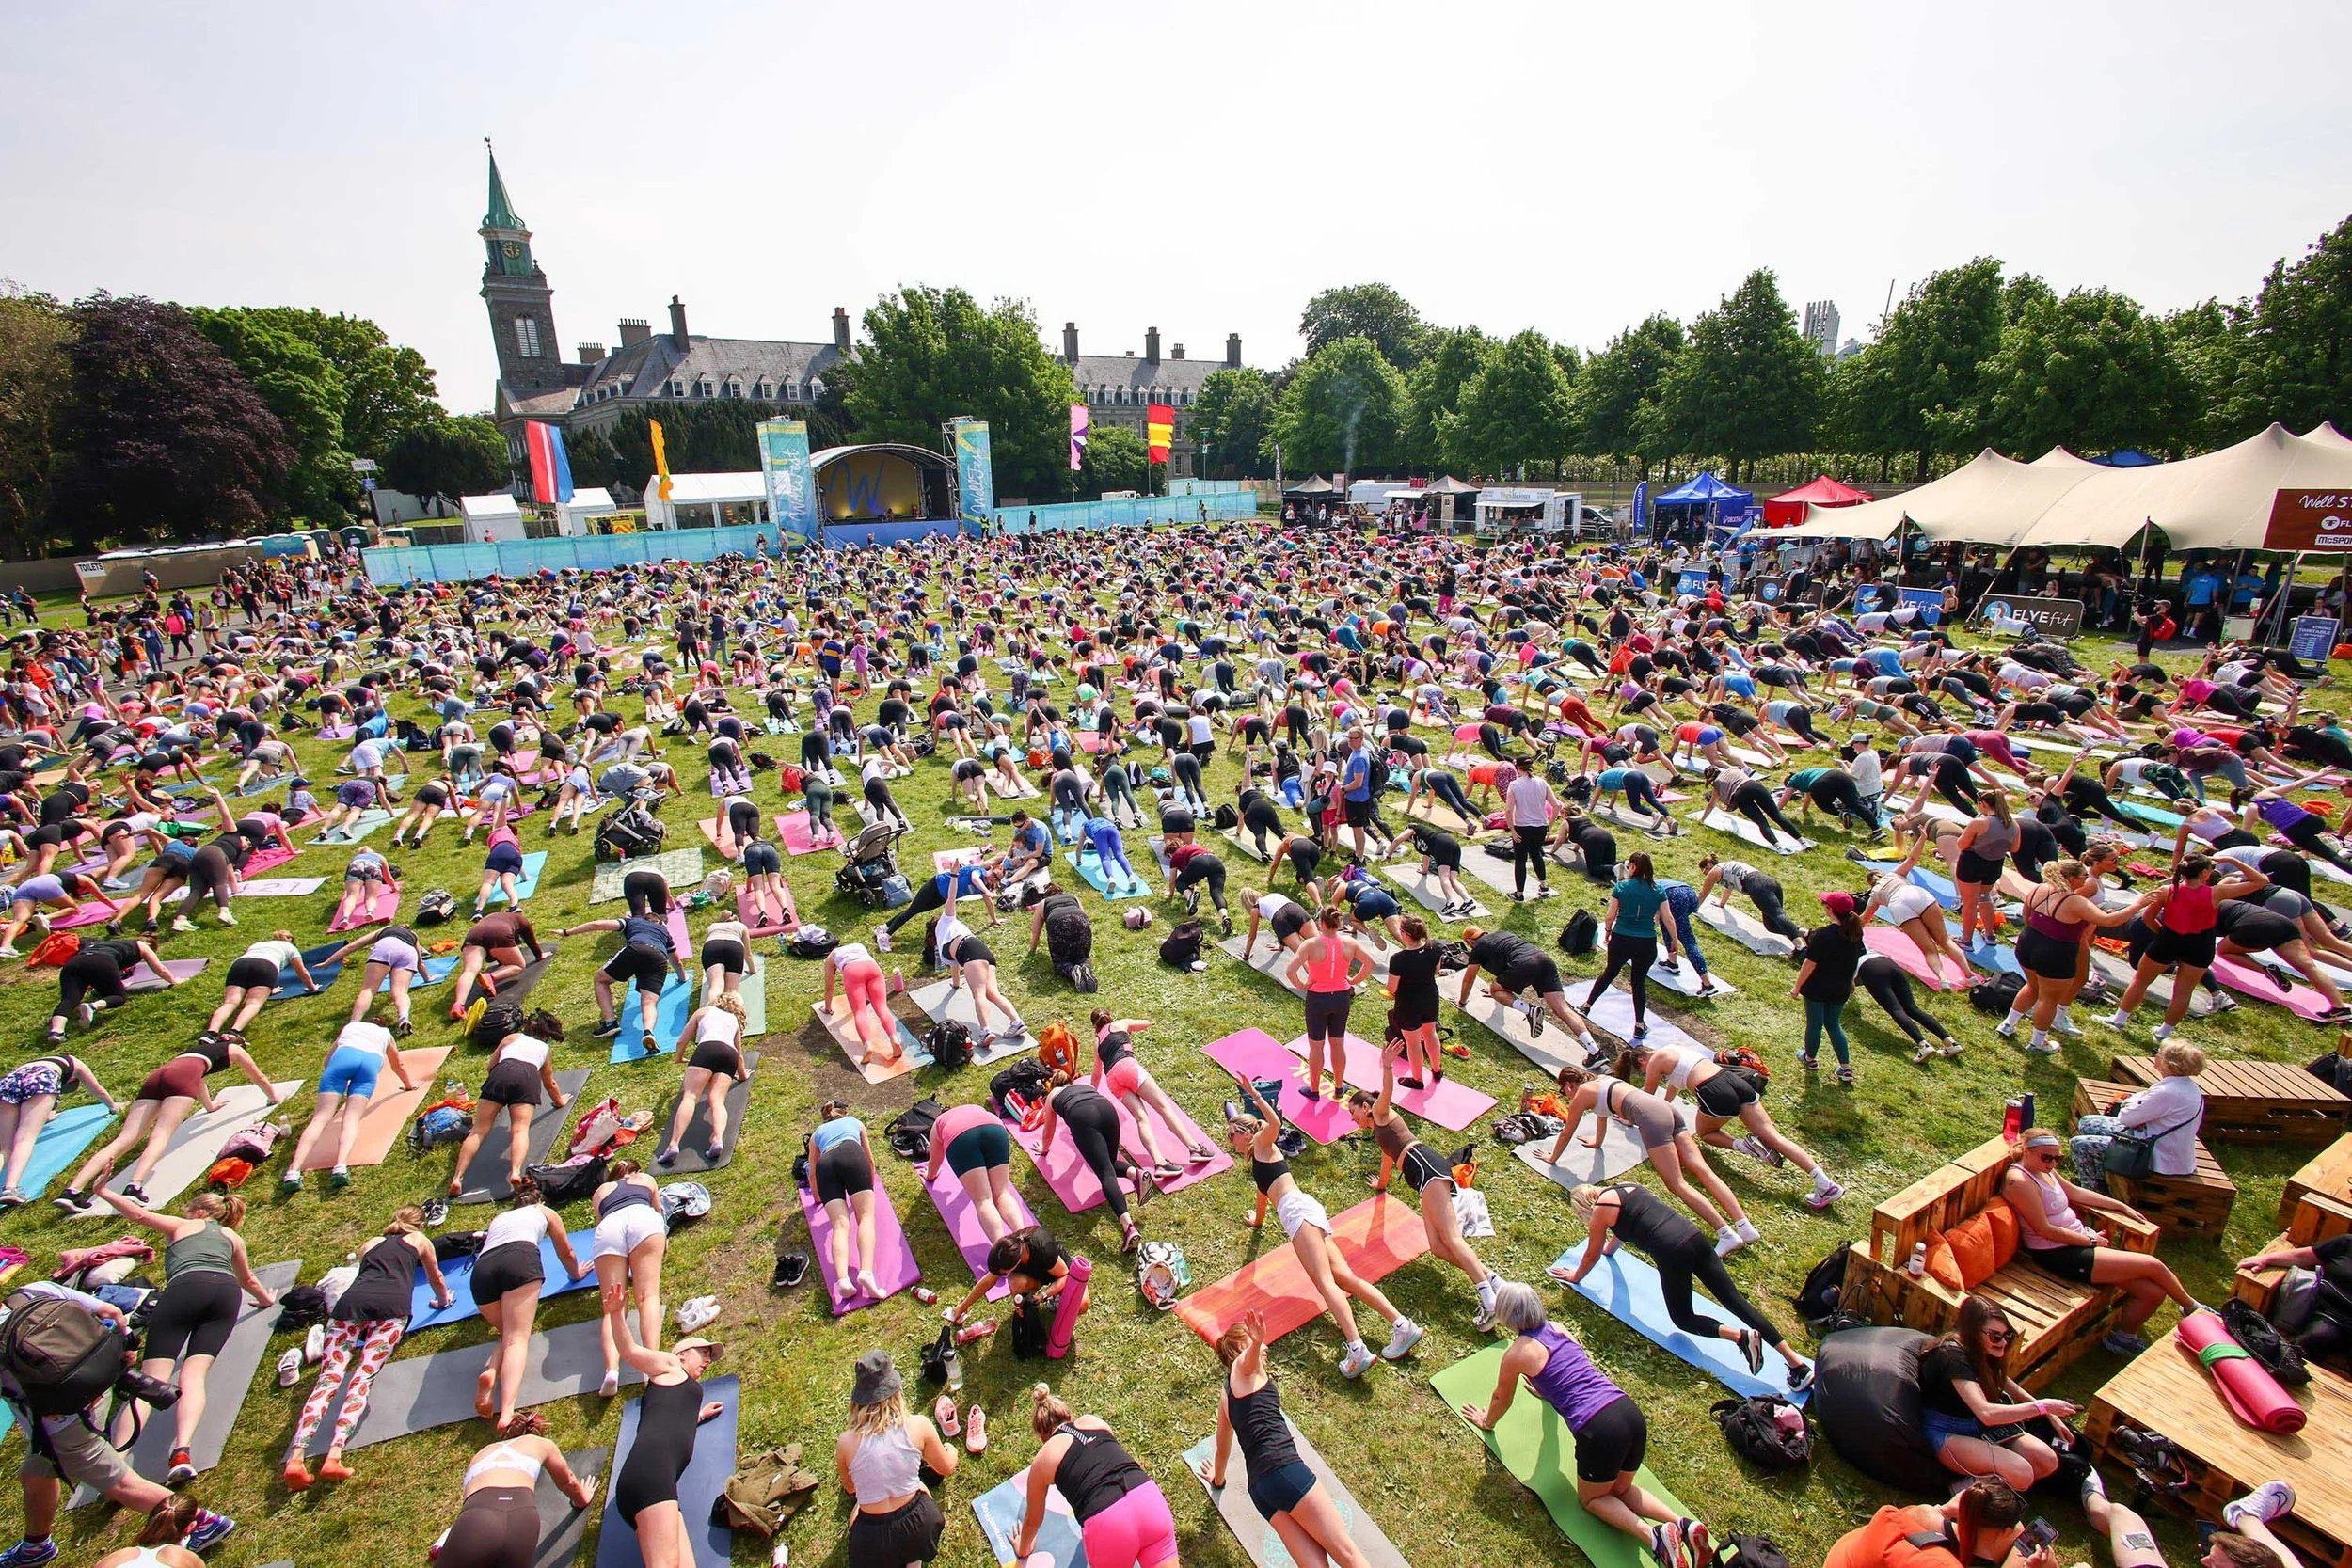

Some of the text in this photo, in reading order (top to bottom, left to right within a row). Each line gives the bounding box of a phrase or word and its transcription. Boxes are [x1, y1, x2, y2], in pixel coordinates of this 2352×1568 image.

[781, 448, 807, 521] WellFest
[2298, 495, 2352, 509] Well S
[78, 562, 103, 573] TOILETS
[2013, 609, 2074, 627] FLYEfit
